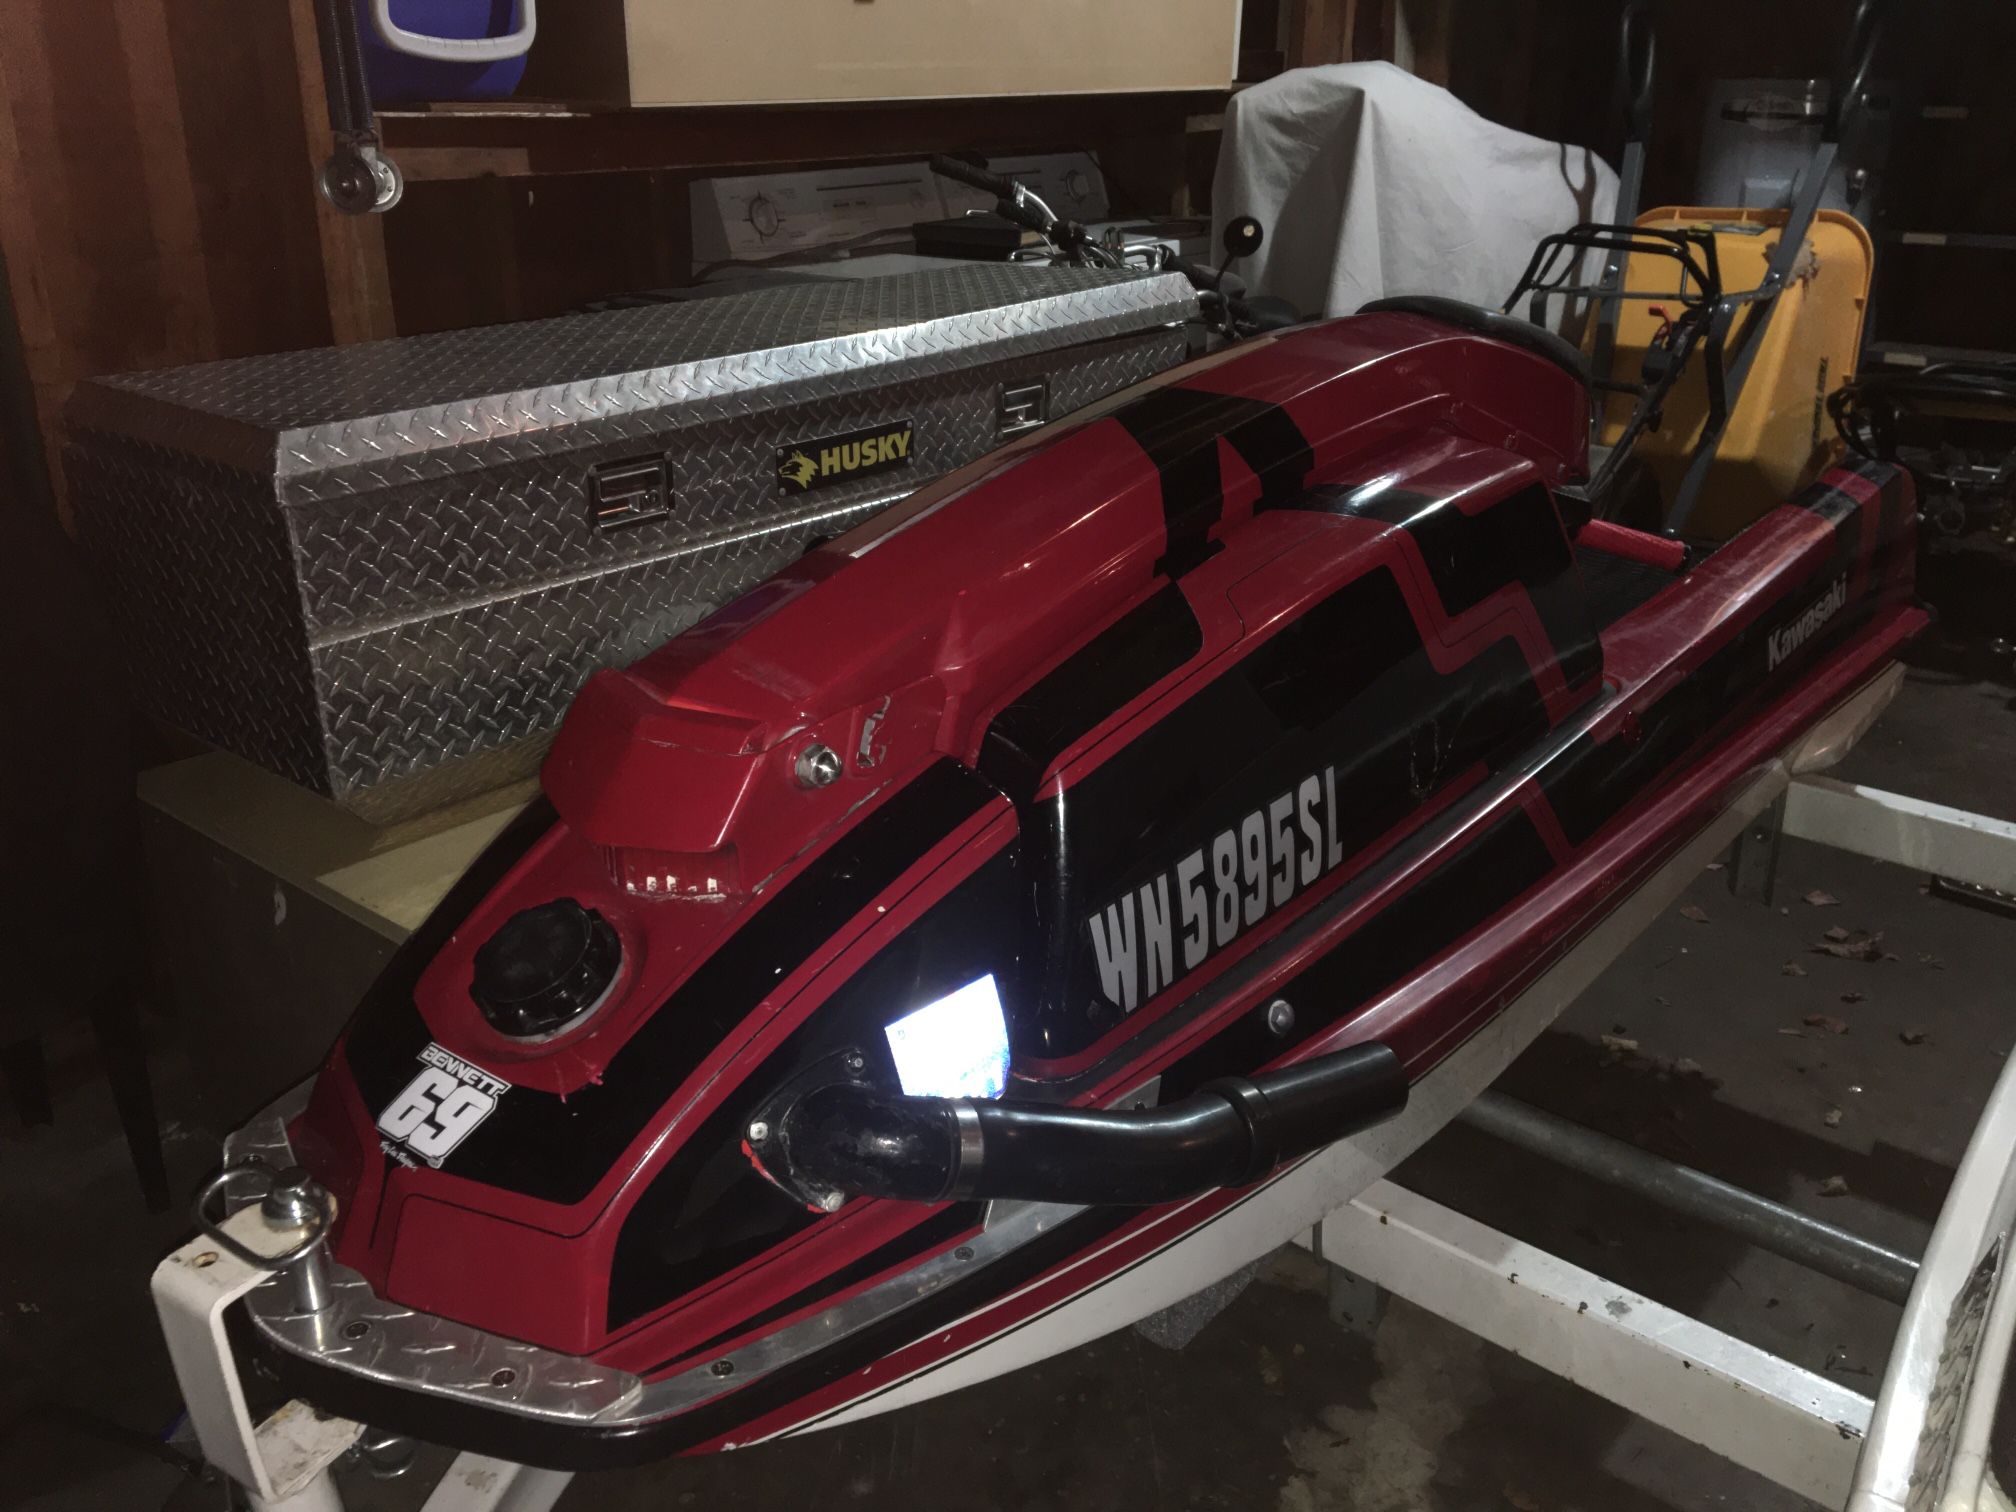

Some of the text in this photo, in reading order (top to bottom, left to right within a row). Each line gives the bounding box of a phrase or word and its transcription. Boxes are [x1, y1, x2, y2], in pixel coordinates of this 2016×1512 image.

[821, 430, 912, 477] HUSKY
[1768, 571, 1847, 673] Kawasaki
[420, 1046, 505, 1097] BENNETT
[377, 1066, 496, 1160] 69
